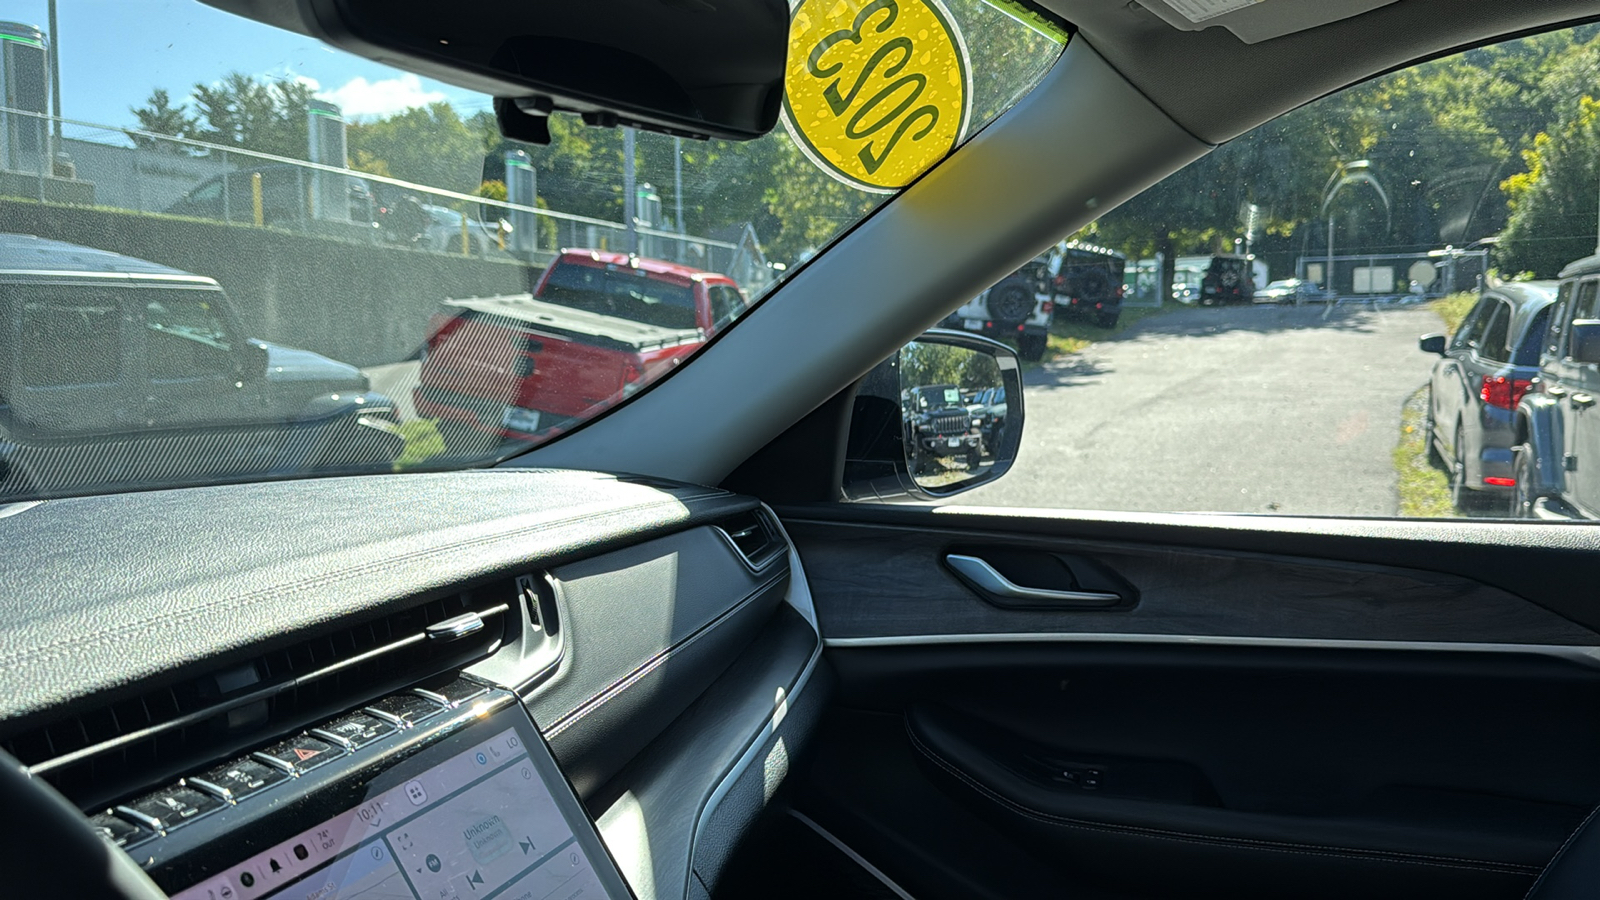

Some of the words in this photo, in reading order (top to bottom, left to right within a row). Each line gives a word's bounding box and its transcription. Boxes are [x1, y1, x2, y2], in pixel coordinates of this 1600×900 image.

[506, 736, 519, 749] LO
[356, 802, 384, 822] 10:11
[463, 814, 500, 841] Unknown
[321, 838, 336, 850] OUT
[473, 829, 503, 850] Unknown
